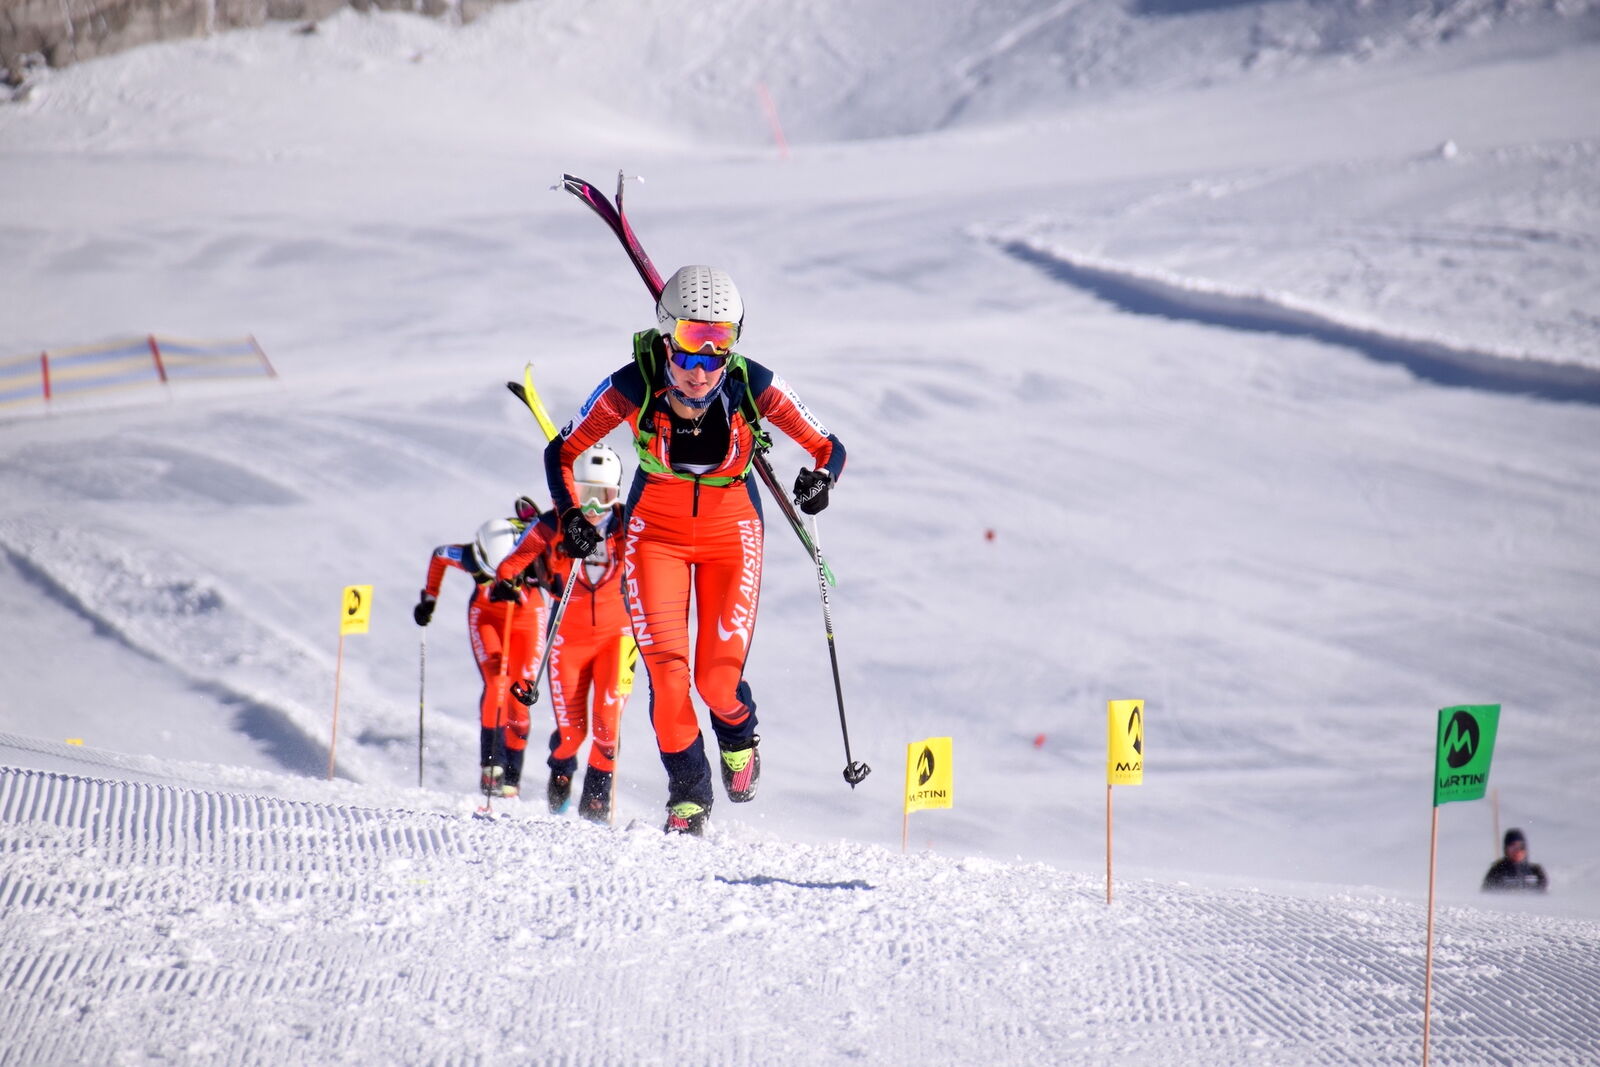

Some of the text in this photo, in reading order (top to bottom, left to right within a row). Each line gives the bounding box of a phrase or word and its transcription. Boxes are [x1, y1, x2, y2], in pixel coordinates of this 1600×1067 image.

[624, 534, 654, 647] MARTINI
[737, 519, 757, 602] AUSTRIA
[745, 518, 763, 630] MOUNTAINEERING
[550, 646, 571, 727] MARTINI
